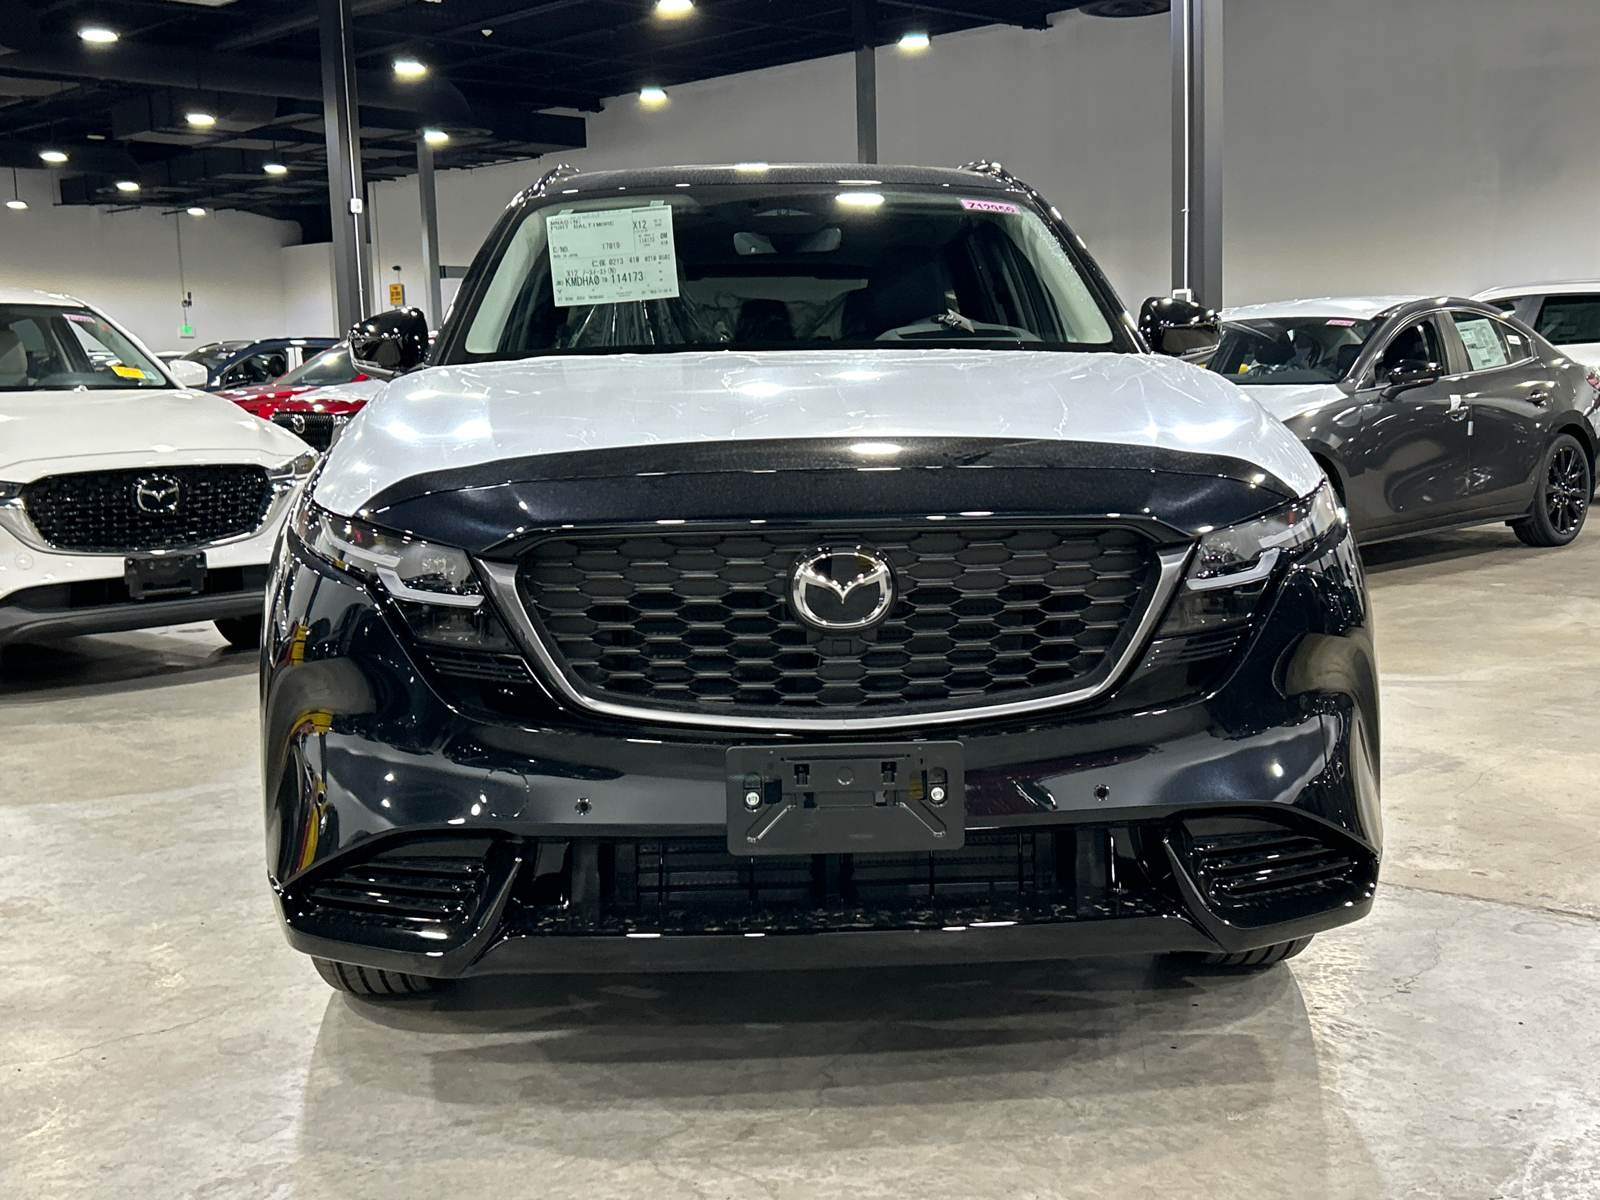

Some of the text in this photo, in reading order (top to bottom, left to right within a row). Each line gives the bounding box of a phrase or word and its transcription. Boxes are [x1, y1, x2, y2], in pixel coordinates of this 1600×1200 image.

[573, 221, 615, 229] BALTIMORE
[632, 220, 647, 230] X12
[602, 242, 620, 250] 17019
[566, 269, 578, 277] X12
[611, 271, 644, 284] 114173
